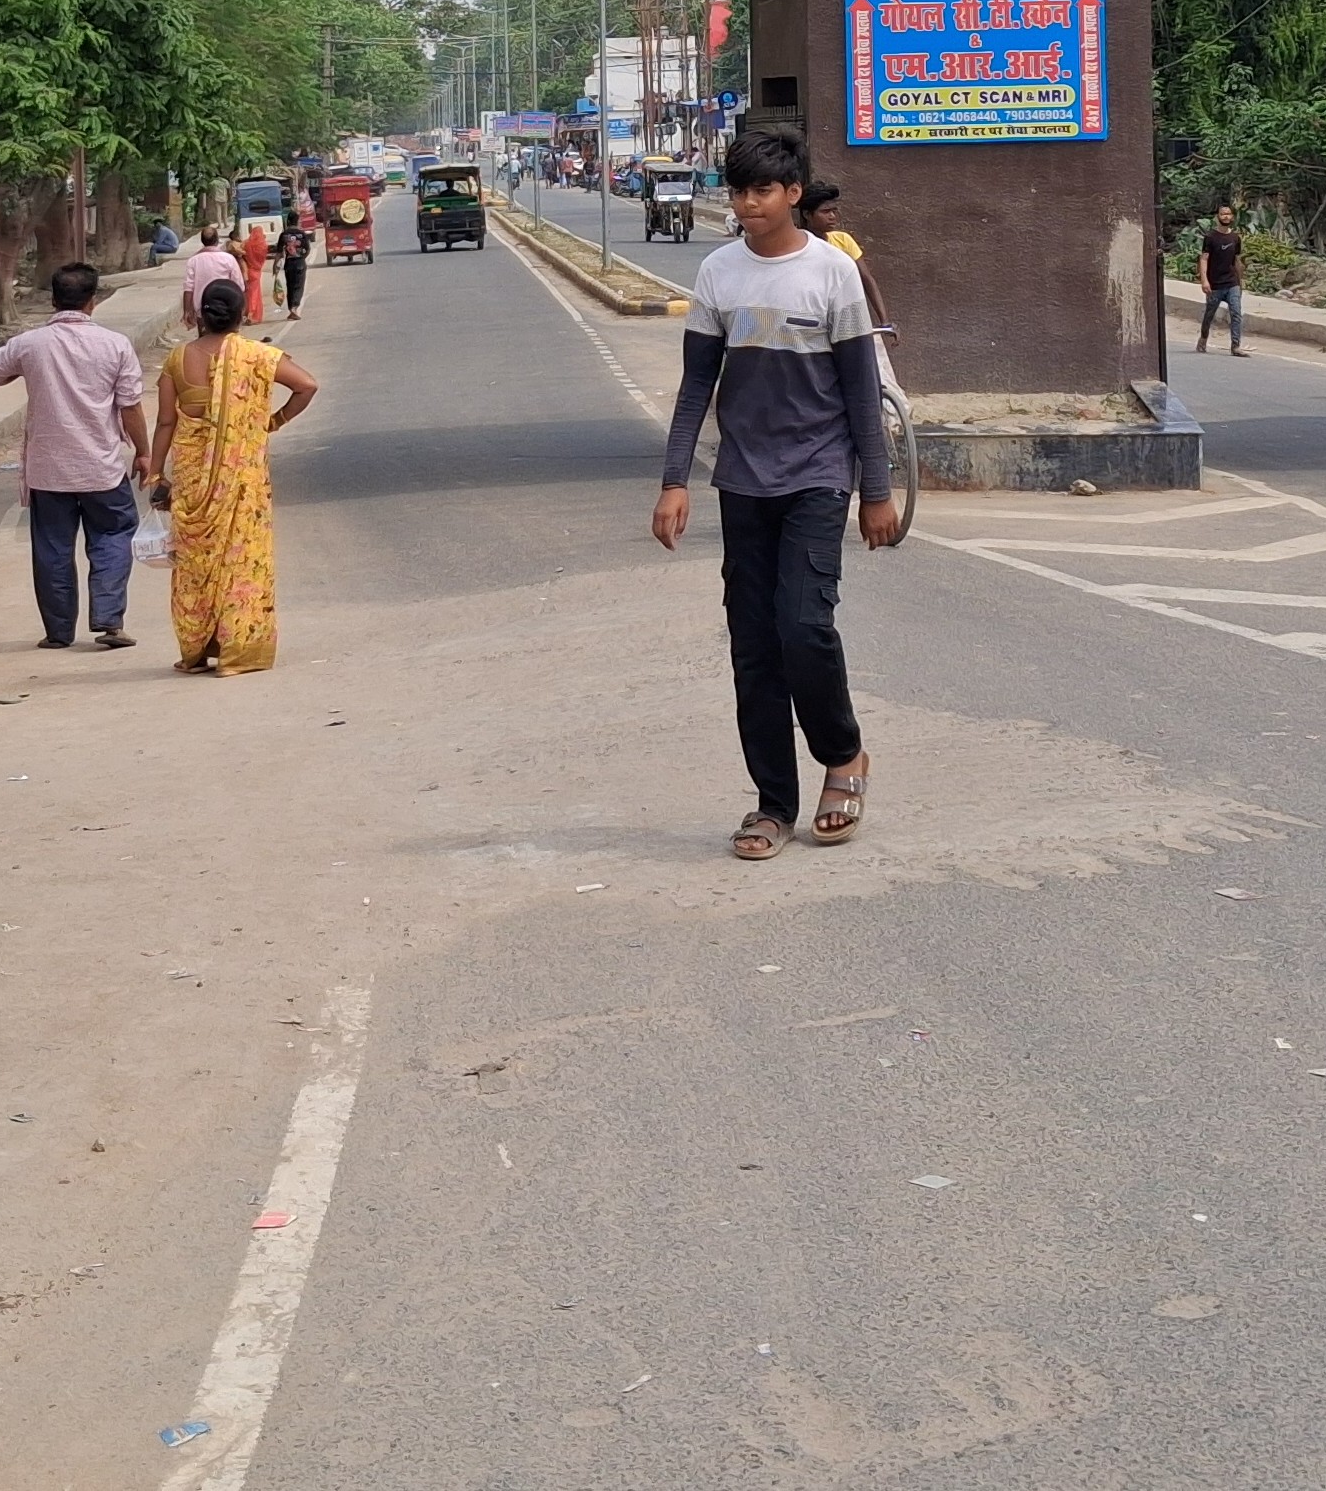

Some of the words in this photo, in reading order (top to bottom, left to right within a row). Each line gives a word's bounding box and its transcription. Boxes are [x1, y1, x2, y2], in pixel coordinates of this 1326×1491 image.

[969, 33, 982, 48] &
[887, 92, 943, 106] GOYAL
[950, 92, 971, 104] CT
[979, 91, 1023, 104] SCAN
[1038, 90, 1067, 102] MRI
